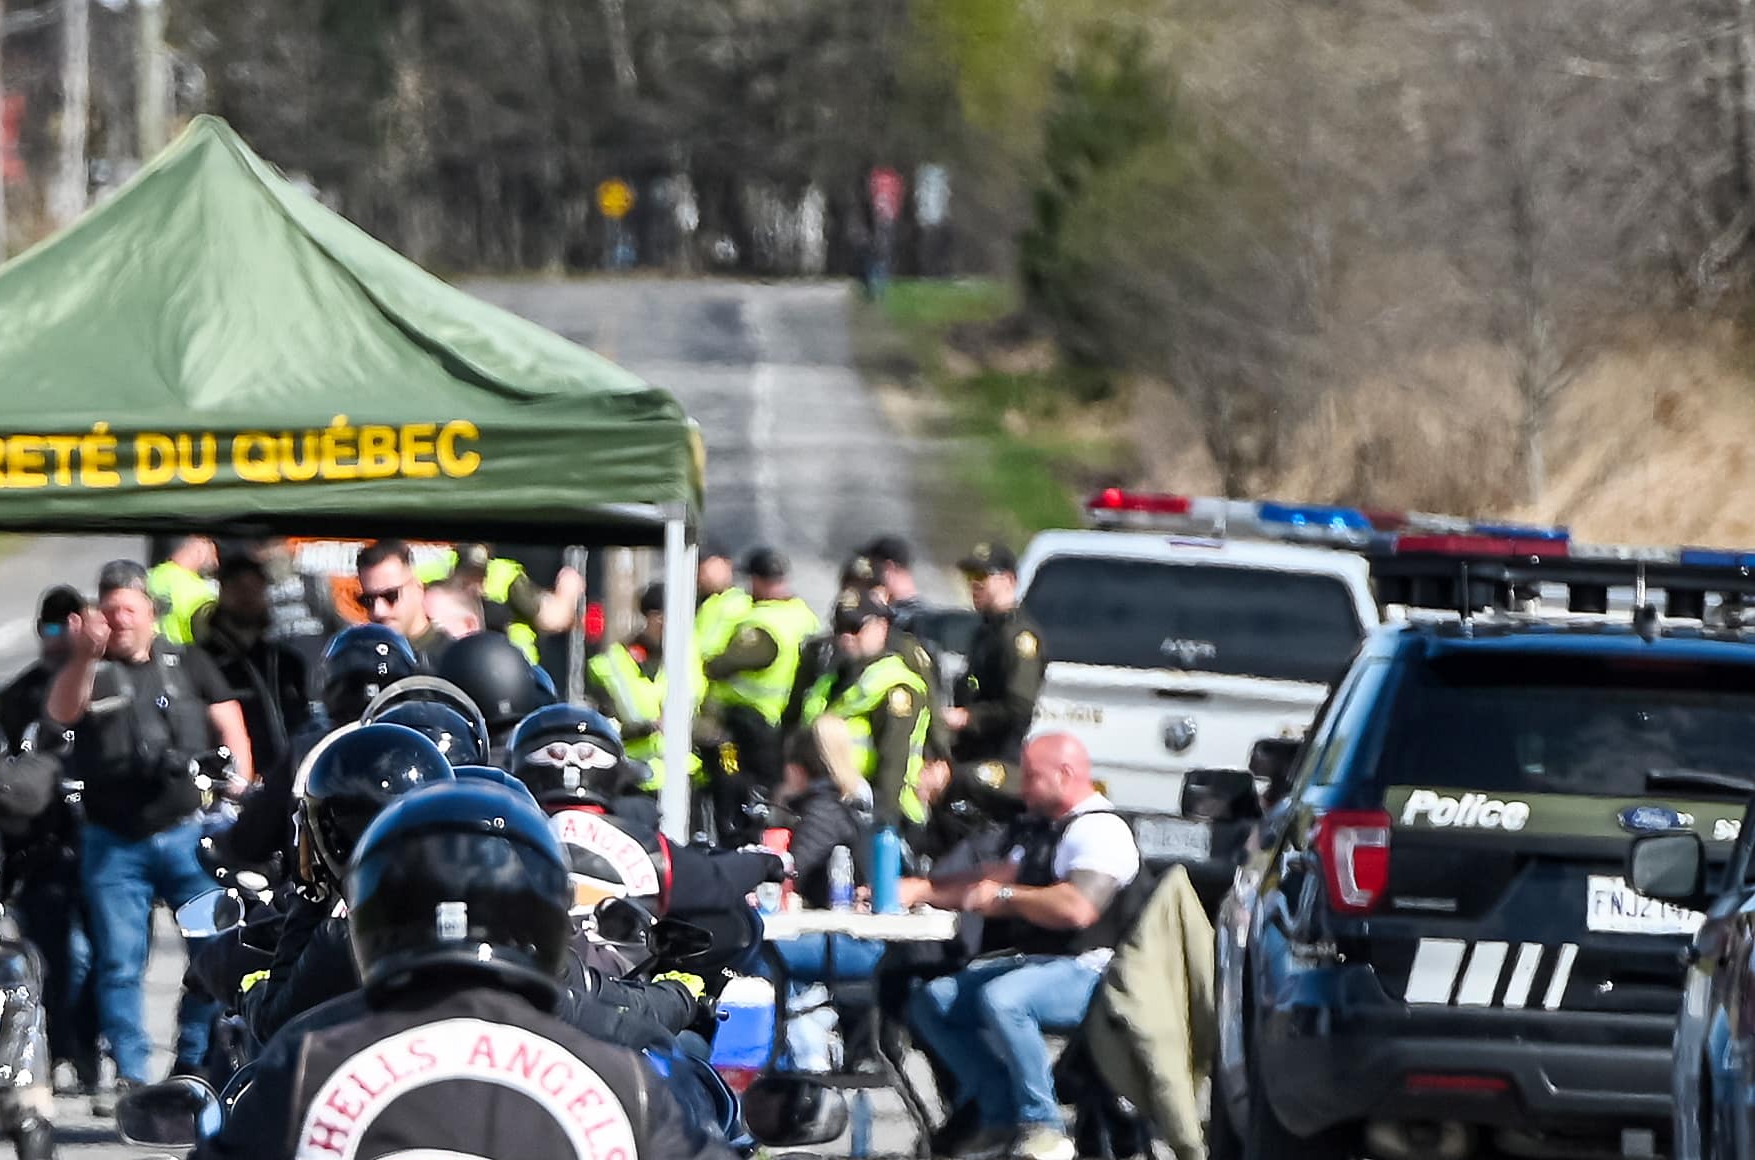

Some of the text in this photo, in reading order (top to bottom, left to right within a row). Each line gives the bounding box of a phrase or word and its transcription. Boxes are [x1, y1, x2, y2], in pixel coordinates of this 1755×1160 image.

[134, 431, 218, 486] DU
[231, 414, 481, 484] QUÉBEC
[1400, 788, 1532, 832] Police
[308, 1038, 438, 1157] HELLS
